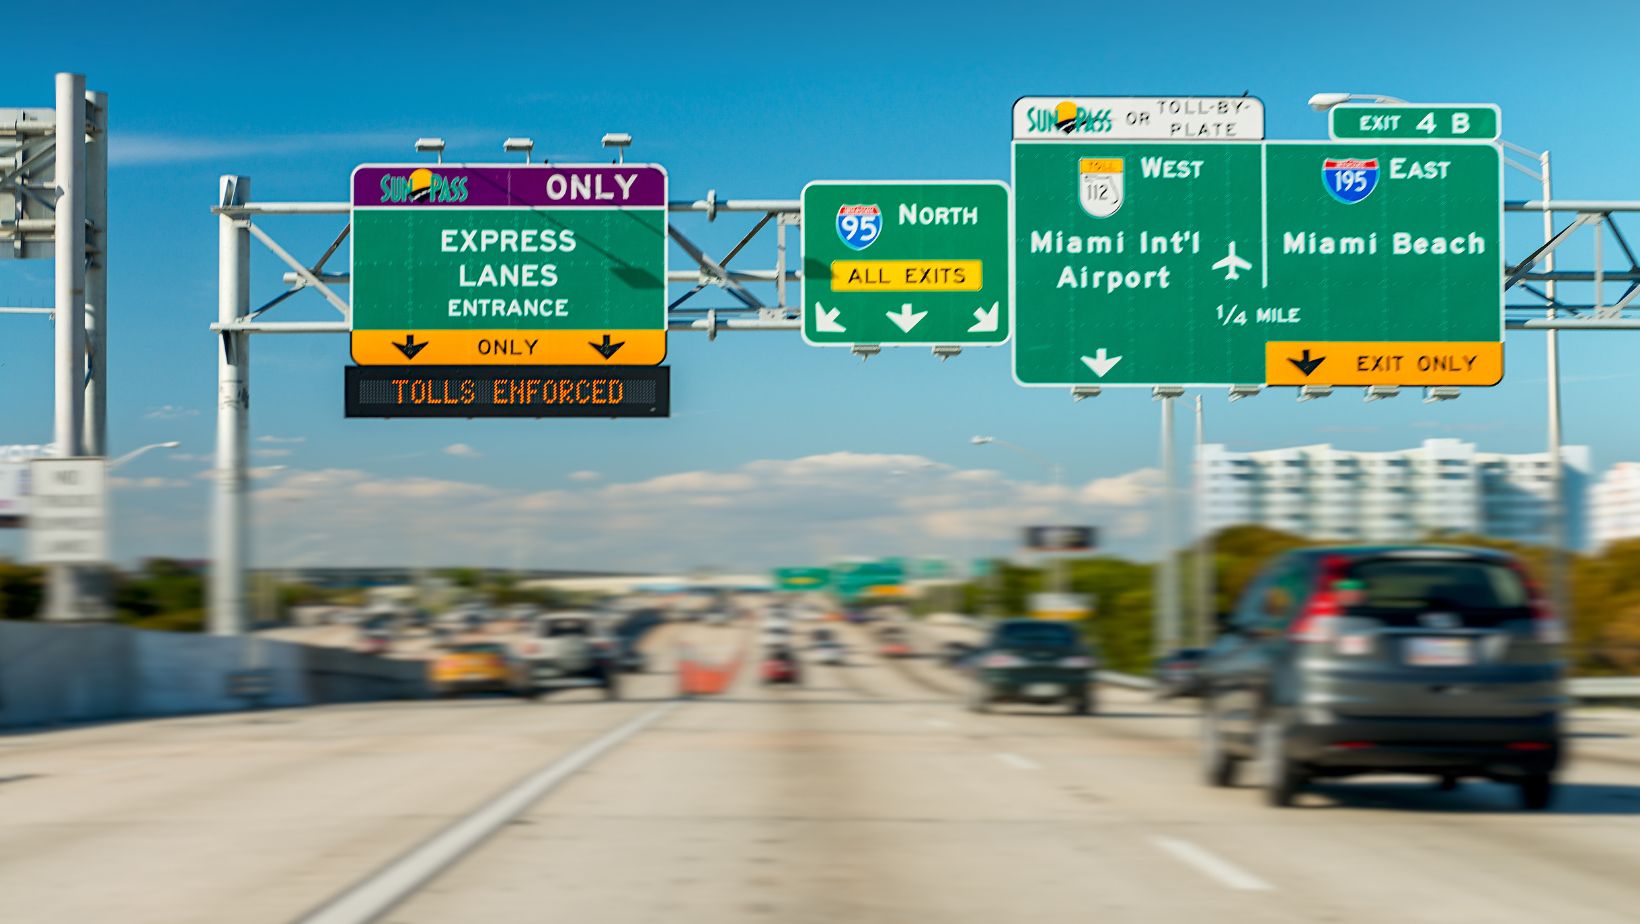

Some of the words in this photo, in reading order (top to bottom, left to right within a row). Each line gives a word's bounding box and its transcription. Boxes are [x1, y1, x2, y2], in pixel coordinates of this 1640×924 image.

[1126, 111, 1151, 126] OR
[1170, 122, 1237, 137] PLATE
[1360, 115, 1402, 132] EXIT
[1416, 112, 1437, 134] 4
[1452, 112, 1471, 135] B
[1140, 156, 1204, 179] WEST
[1389, 157, 1451, 180] EAST
[546, 174, 639, 201] ONLY
[1087, 184, 1109, 201] 112
[1335, 170, 1368, 192] 195
[899, 203, 978, 226] NORTH
[841, 215, 877, 242] 95
[441, 229, 577, 253] EXPRESS
[1030, 230, 1125, 254] Miami
[1139, 230, 1201, 254] Int'l
[1283, 231, 1378, 255] Miami
[1392, 231, 1486, 255] Beach
[459, 264, 559, 288] LANES
[848, 268, 892, 285] ALL
[904, 268, 966, 285] EXITS
[1056, 265, 1171, 294] Airport
[448, 299, 570, 318] ENTRANCE
[1256, 308, 1302, 324] MILE
[477, 339, 539, 355] ONLY
[1356, 355, 1404, 372] EXIT
[1417, 355, 1478, 373] ONLY
[391, 379, 476, 405] TOLLS
[493, 379, 624, 405] ENFORCED
